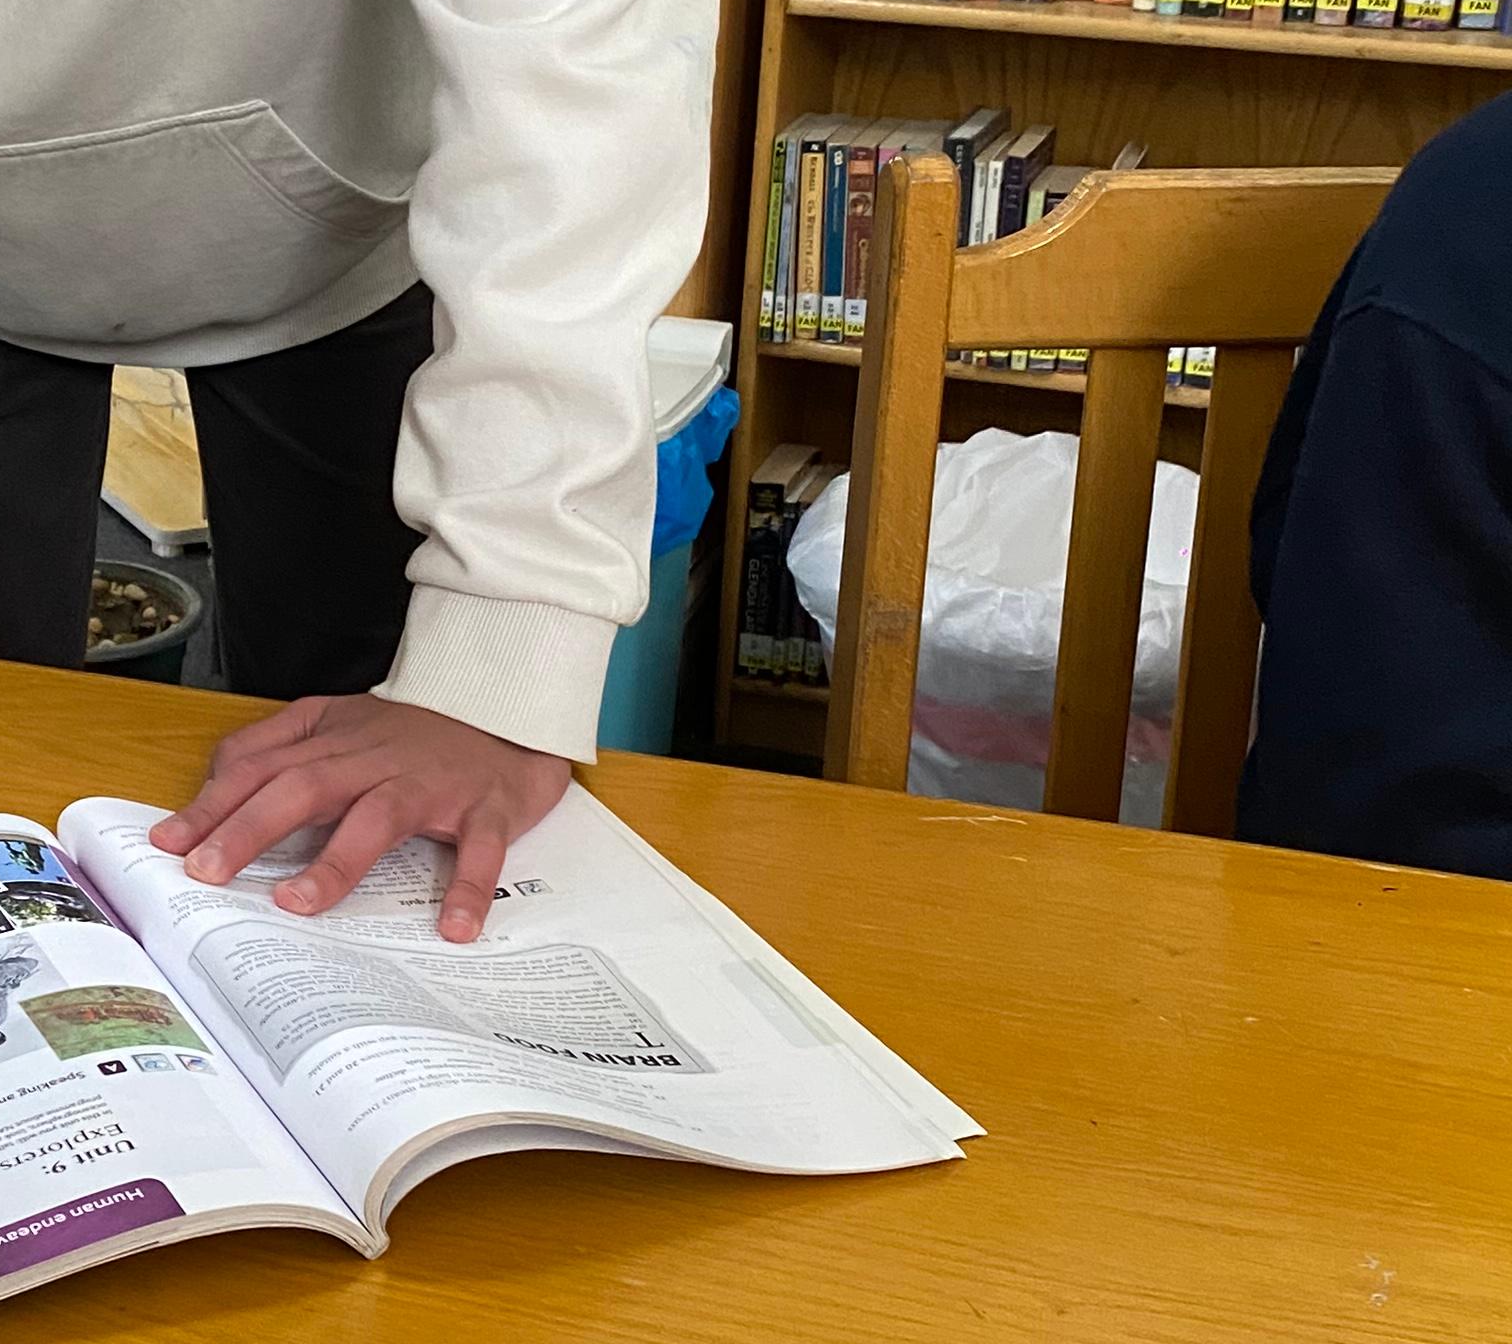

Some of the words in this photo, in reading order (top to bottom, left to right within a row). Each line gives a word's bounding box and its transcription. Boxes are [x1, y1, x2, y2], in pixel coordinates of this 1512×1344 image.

[1469, 0, 1491, 10] FAN
[493, 1031, 578, 1061] FOOD
[583, 1050, 682, 1068] BRAIN
[16, 1070, 87, 1100] Speaking
[0, 1122, 124, 1171] Explorers
[75, 1139, 136, 1167] Unit
[42, 1159, 65, 1176] 9:
[70, 1186, 144, 1219] Human
